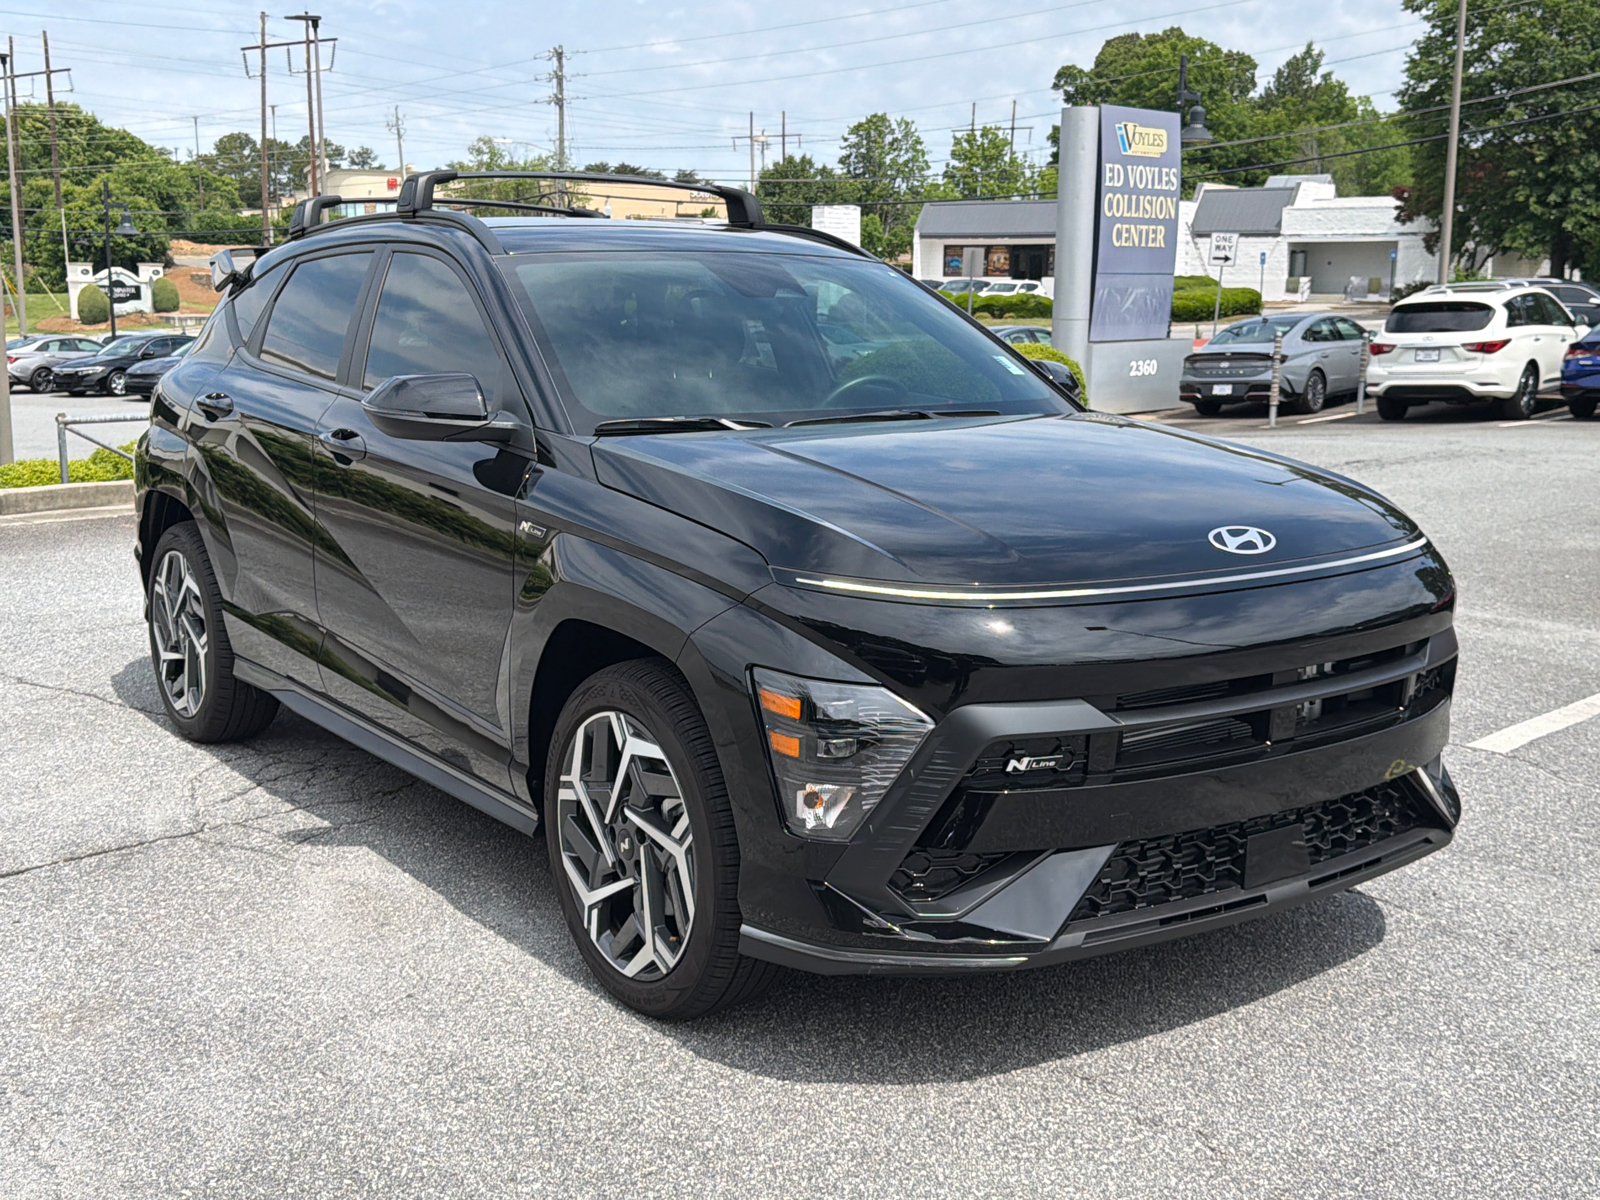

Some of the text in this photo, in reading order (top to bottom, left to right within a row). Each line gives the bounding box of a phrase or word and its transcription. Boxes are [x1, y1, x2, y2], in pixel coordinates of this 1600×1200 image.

[1123, 124, 1164, 150] VOYLES
[1104, 163, 1178, 191] ED VOYLES
[1104, 193, 1176, 220] COLLISION
[1112, 223, 1166, 248] CENTER
[1215, 235, 1234, 243] ONE
[1215, 244, 1234, 252] WAY
[1129, 359, 1158, 376] 2360
[1006, 757, 1030, 772] N
